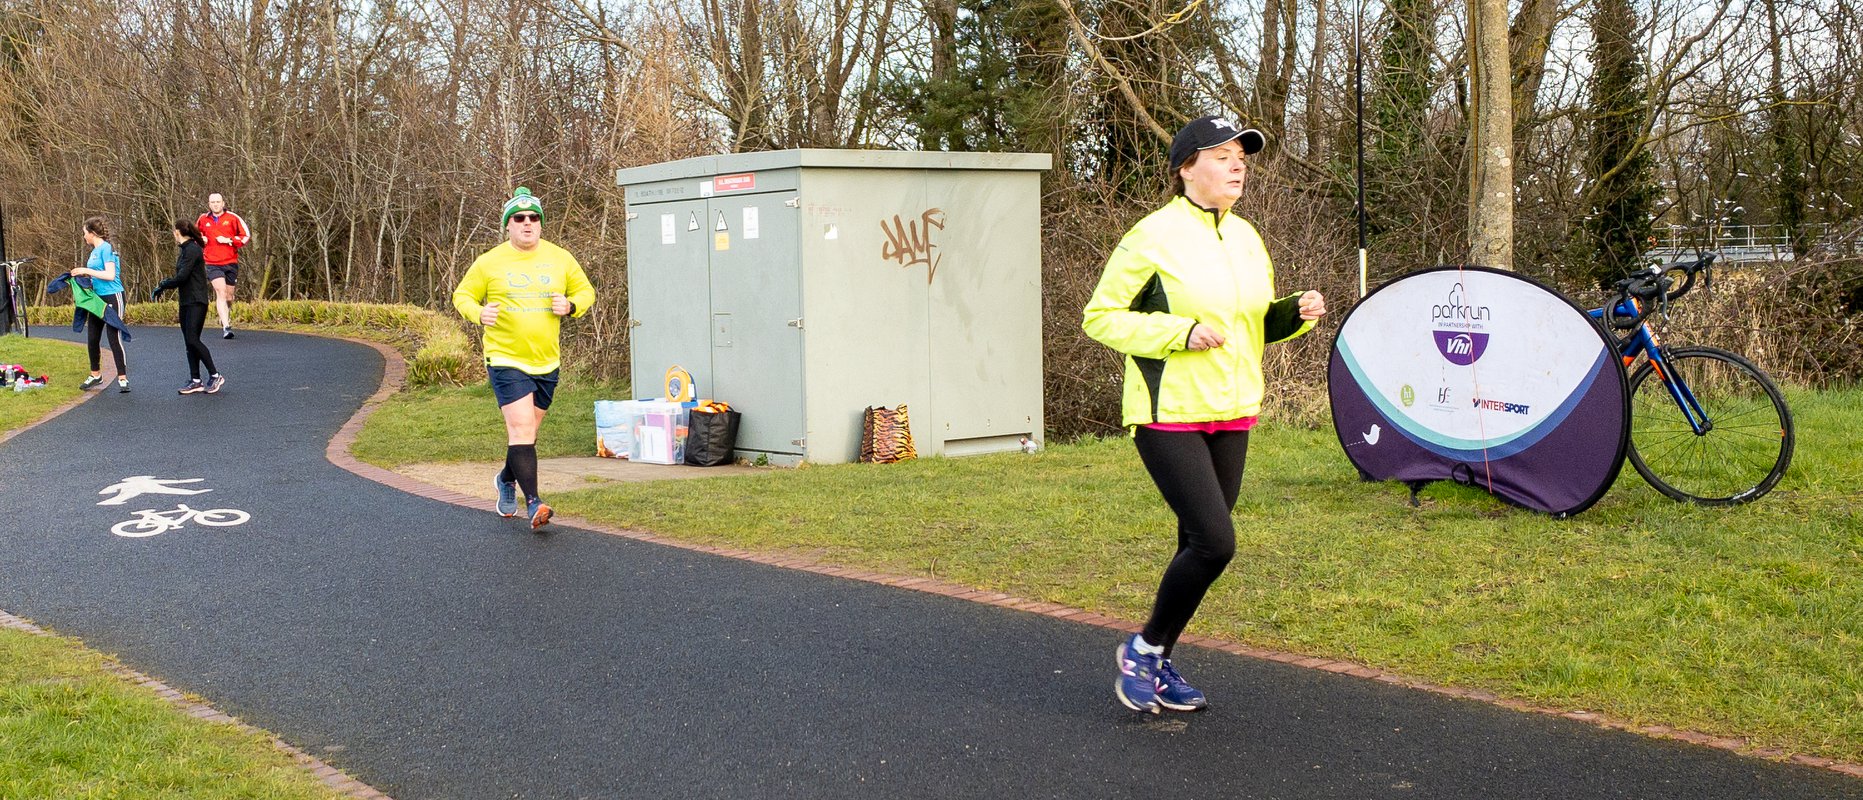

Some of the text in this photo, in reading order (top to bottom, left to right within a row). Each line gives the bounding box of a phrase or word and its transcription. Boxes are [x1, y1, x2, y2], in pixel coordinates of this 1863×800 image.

[1432, 294, 1490, 322] parkrun
[1447, 337, 1472, 355] Vhi
[1481, 399, 1530, 415] INTERSPORT
